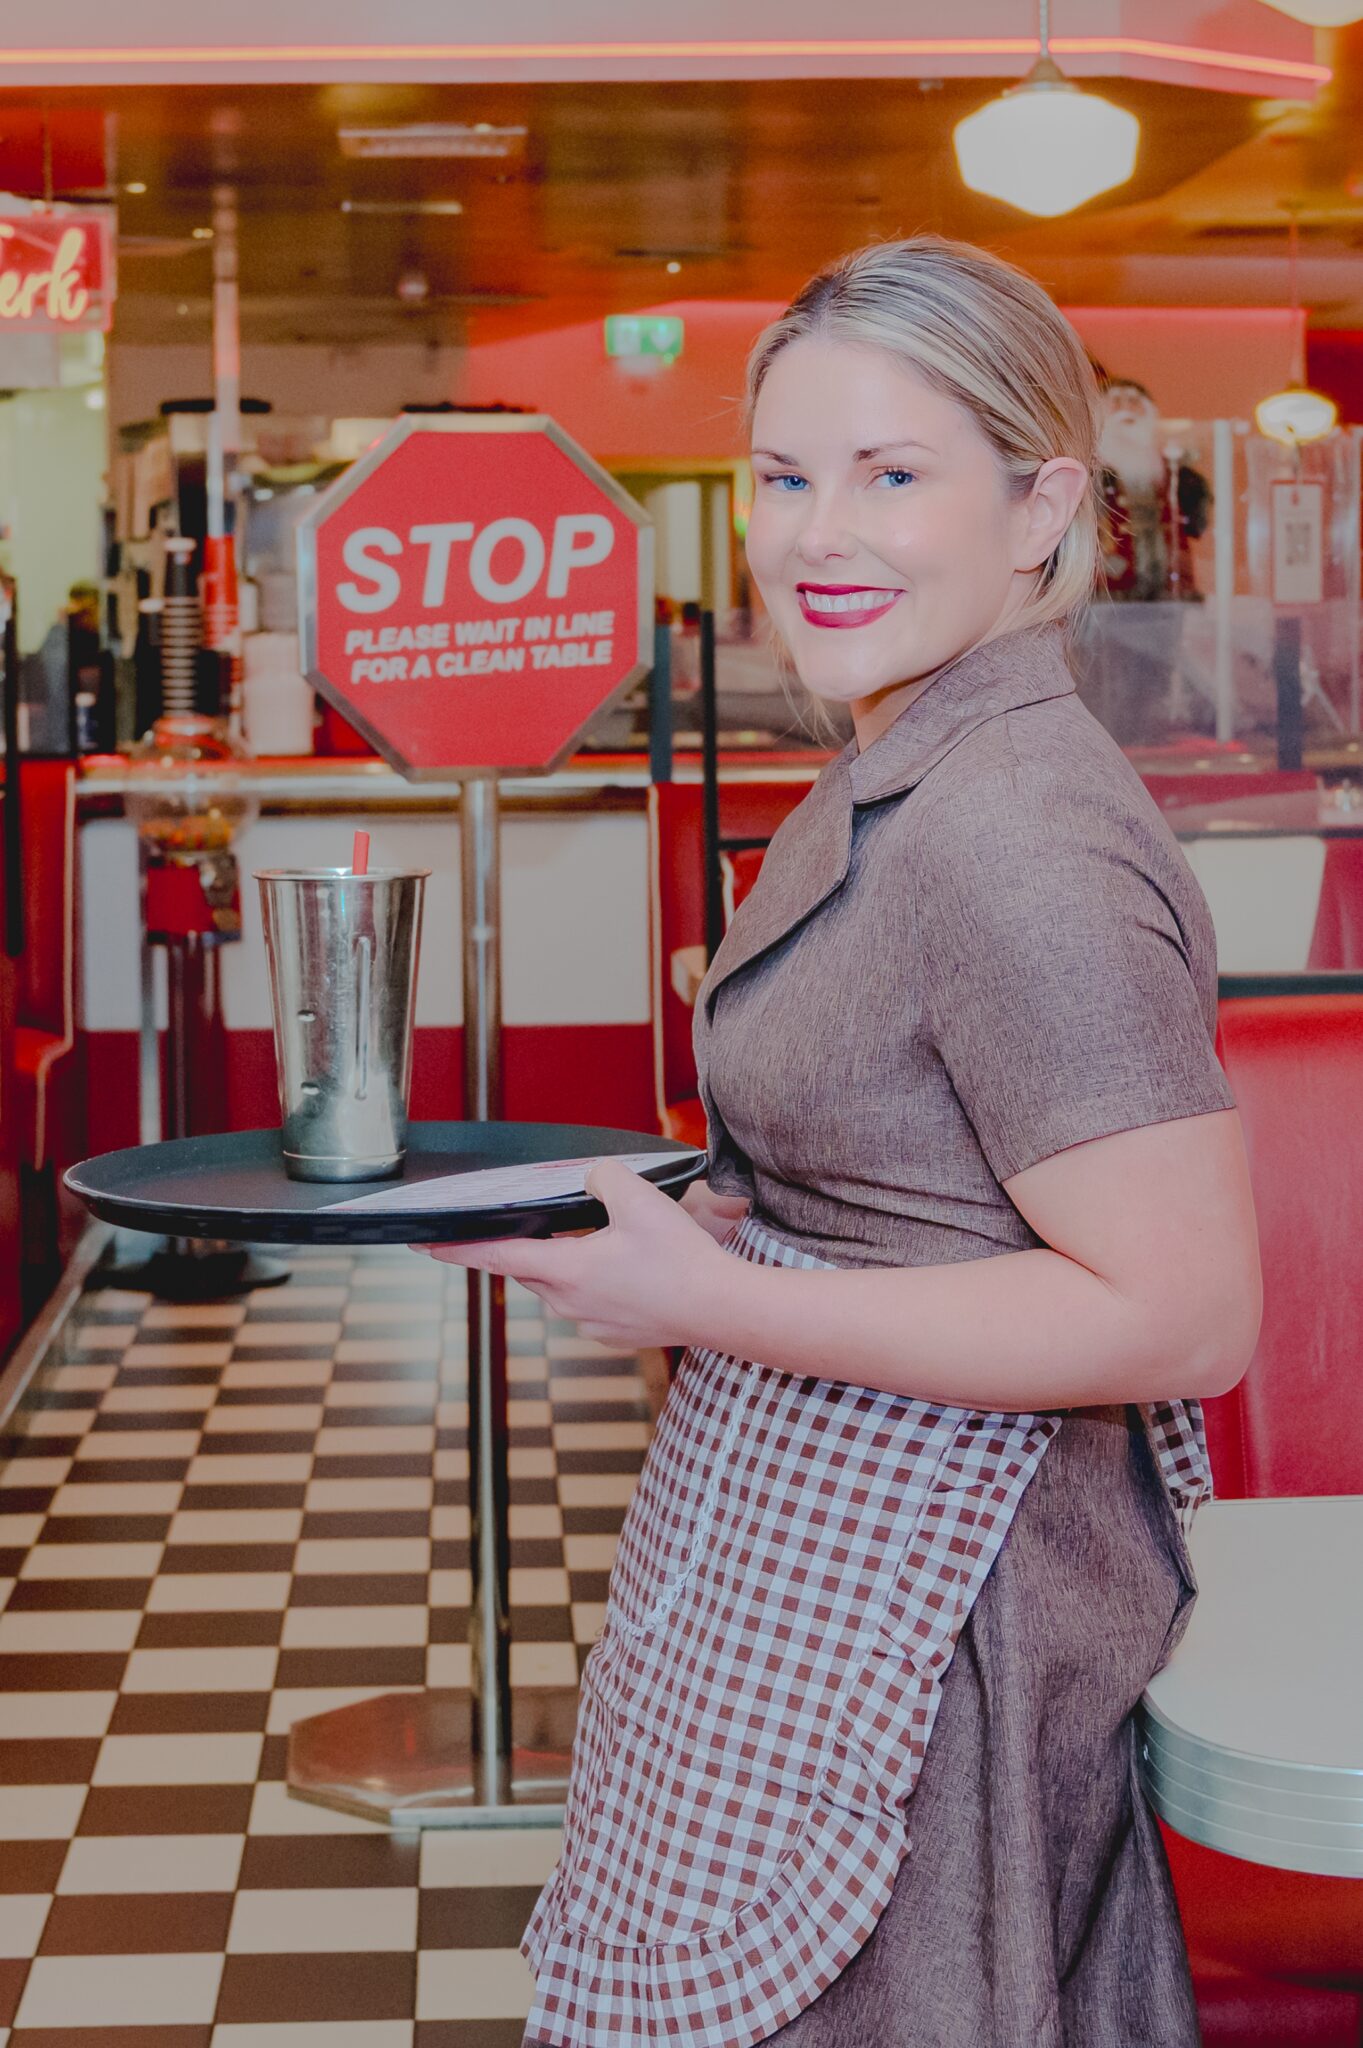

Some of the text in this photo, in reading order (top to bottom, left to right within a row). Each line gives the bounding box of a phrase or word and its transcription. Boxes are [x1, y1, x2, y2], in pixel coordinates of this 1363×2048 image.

[0, 222, 89, 321] erk
[336, 514, 614, 614] STOP
[345, 610, 615, 655] PLEASE WAIT IN LINE
[351, 640, 613, 685] FOR A CLEAN TABLE
